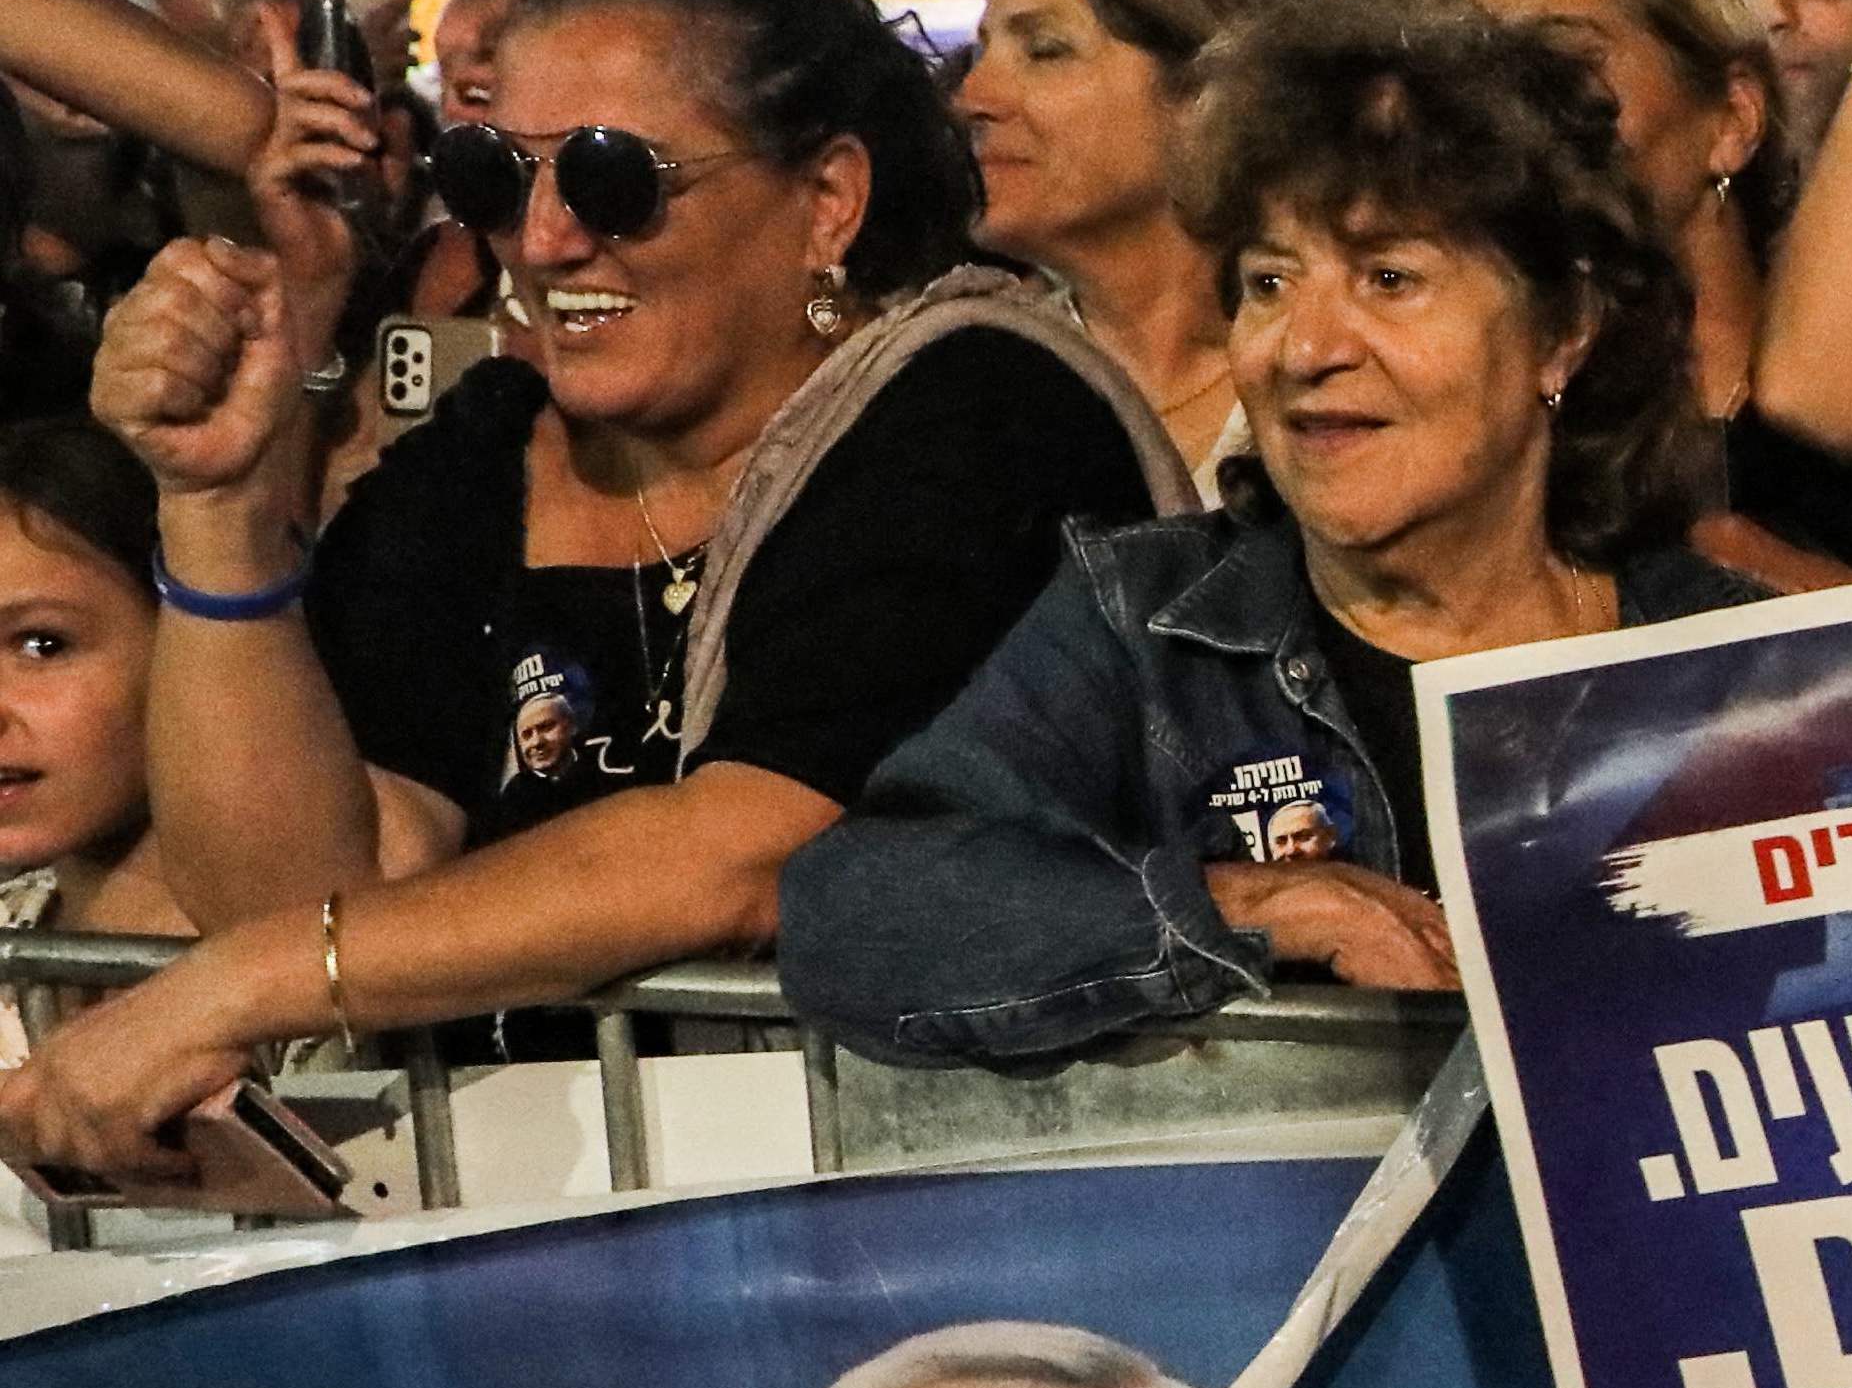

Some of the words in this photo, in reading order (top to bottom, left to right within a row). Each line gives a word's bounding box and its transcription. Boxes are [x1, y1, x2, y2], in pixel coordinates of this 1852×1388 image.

[1230, 755, 1304, 791] נתניהו.
[1271, 784, 1297, 804] חזק
[1298, 779, 1323, 799] ימין
